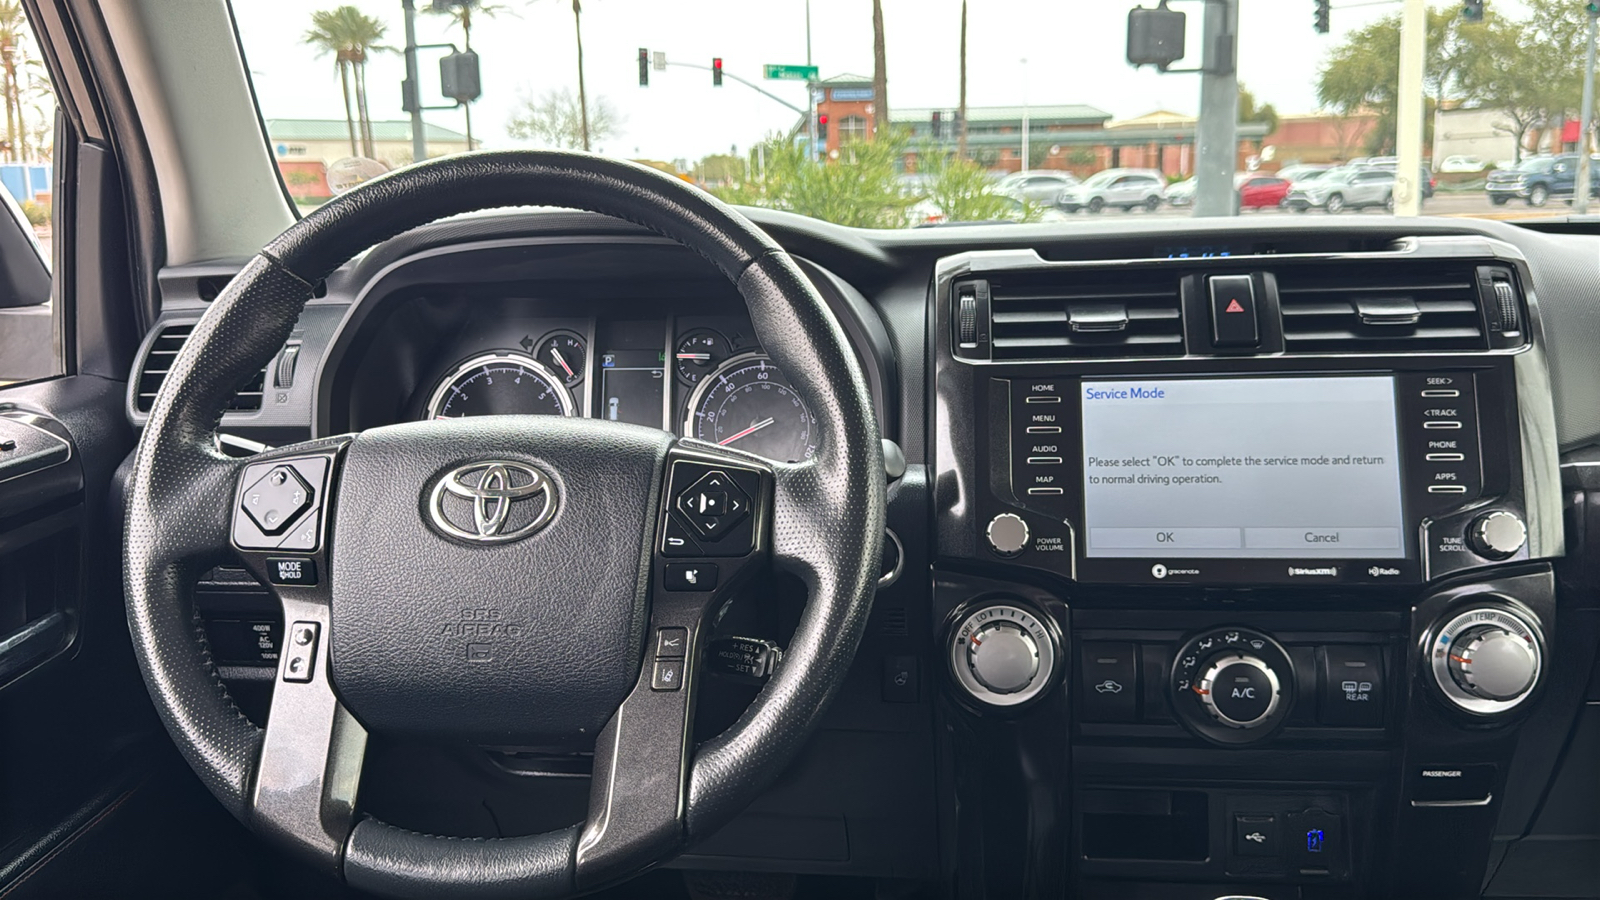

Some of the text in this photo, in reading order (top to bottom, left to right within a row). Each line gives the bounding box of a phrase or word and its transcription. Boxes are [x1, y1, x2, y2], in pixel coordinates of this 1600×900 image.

[724, 382, 736, 392] 40
[1086, 387, 1165, 399] Service Mode
[706, 411, 715, 422] 20
[804, 444, 816, 458] 120
[1088, 457, 1119, 466] Please
[1122, 457, 1150, 466] select
[1182, 458, 1193, 466] to
[1195, 456, 1242, 469] complete
[1244, 456, 1262, 466] the
[1264, 456, 1298, 465] service
[1300, 455, 1329, 465] mode
[1332, 455, 1350, 465] and
[1352, 456, 1384, 465] return
[1089, 474, 1222, 486] to normal driving operation.
[1156, 532, 1174, 542] OK
[1305, 532, 1339, 543] Cancel
[278, 562, 301, 571] MODE
[461, 609, 501, 620] SRS
[976, 612, 988, 623] LO
[1474, 612, 1496, 622] TEMP
[441, 624, 521, 635] AIRBAG
[962, 621, 974, 637] OFF
[1035, 629, 1044, 639] HI
[740, 644, 753, 652] RES
[736, 664, 750, 672] SET
[1231, 687, 1255, 699] A/C
[1346, 693, 1368, 701] REAR
